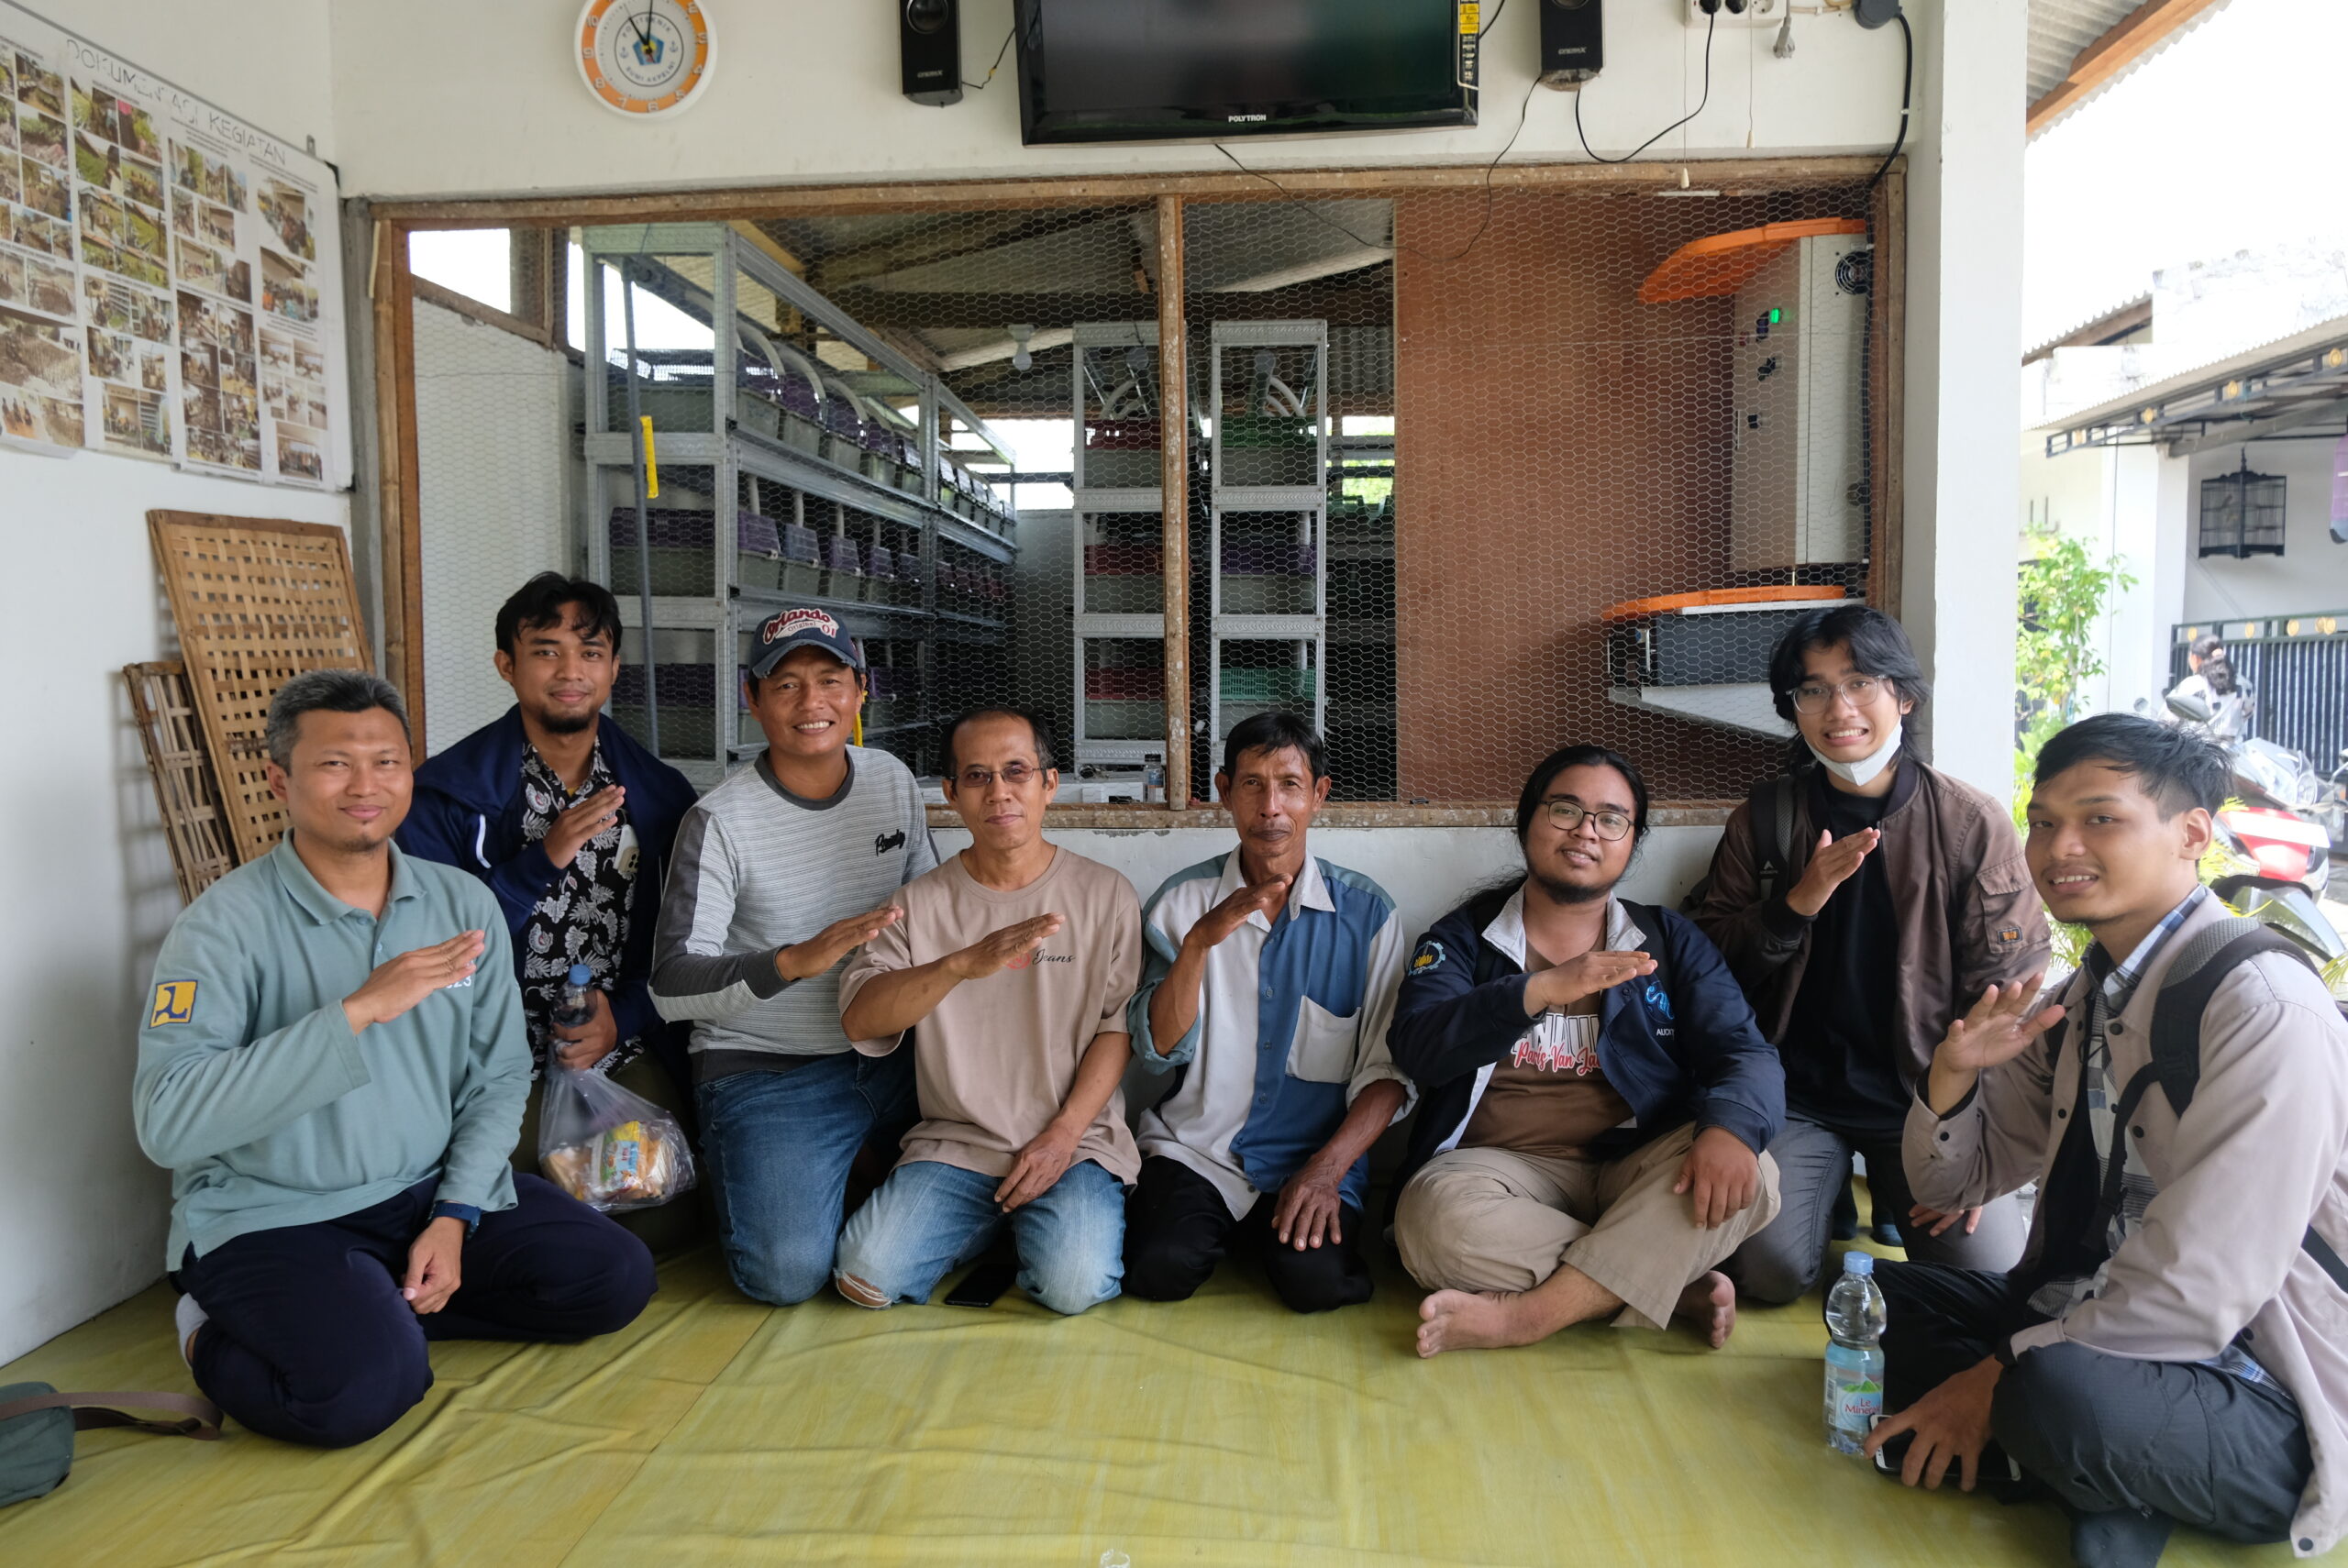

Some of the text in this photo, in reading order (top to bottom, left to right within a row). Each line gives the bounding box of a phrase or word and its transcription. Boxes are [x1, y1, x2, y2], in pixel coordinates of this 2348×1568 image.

[622, 17, 670, 38] POITEKNIK
[1227, 114, 1267, 123] POLYTRON
[764, 609, 831, 644] Orlando
[1032, 948, 1076, 966] Jeans
[1514, 1040, 1550, 1072] Paris
[1551, 1042, 1574, 1073] Van
[1860, 1397, 1871, 1408] Le
